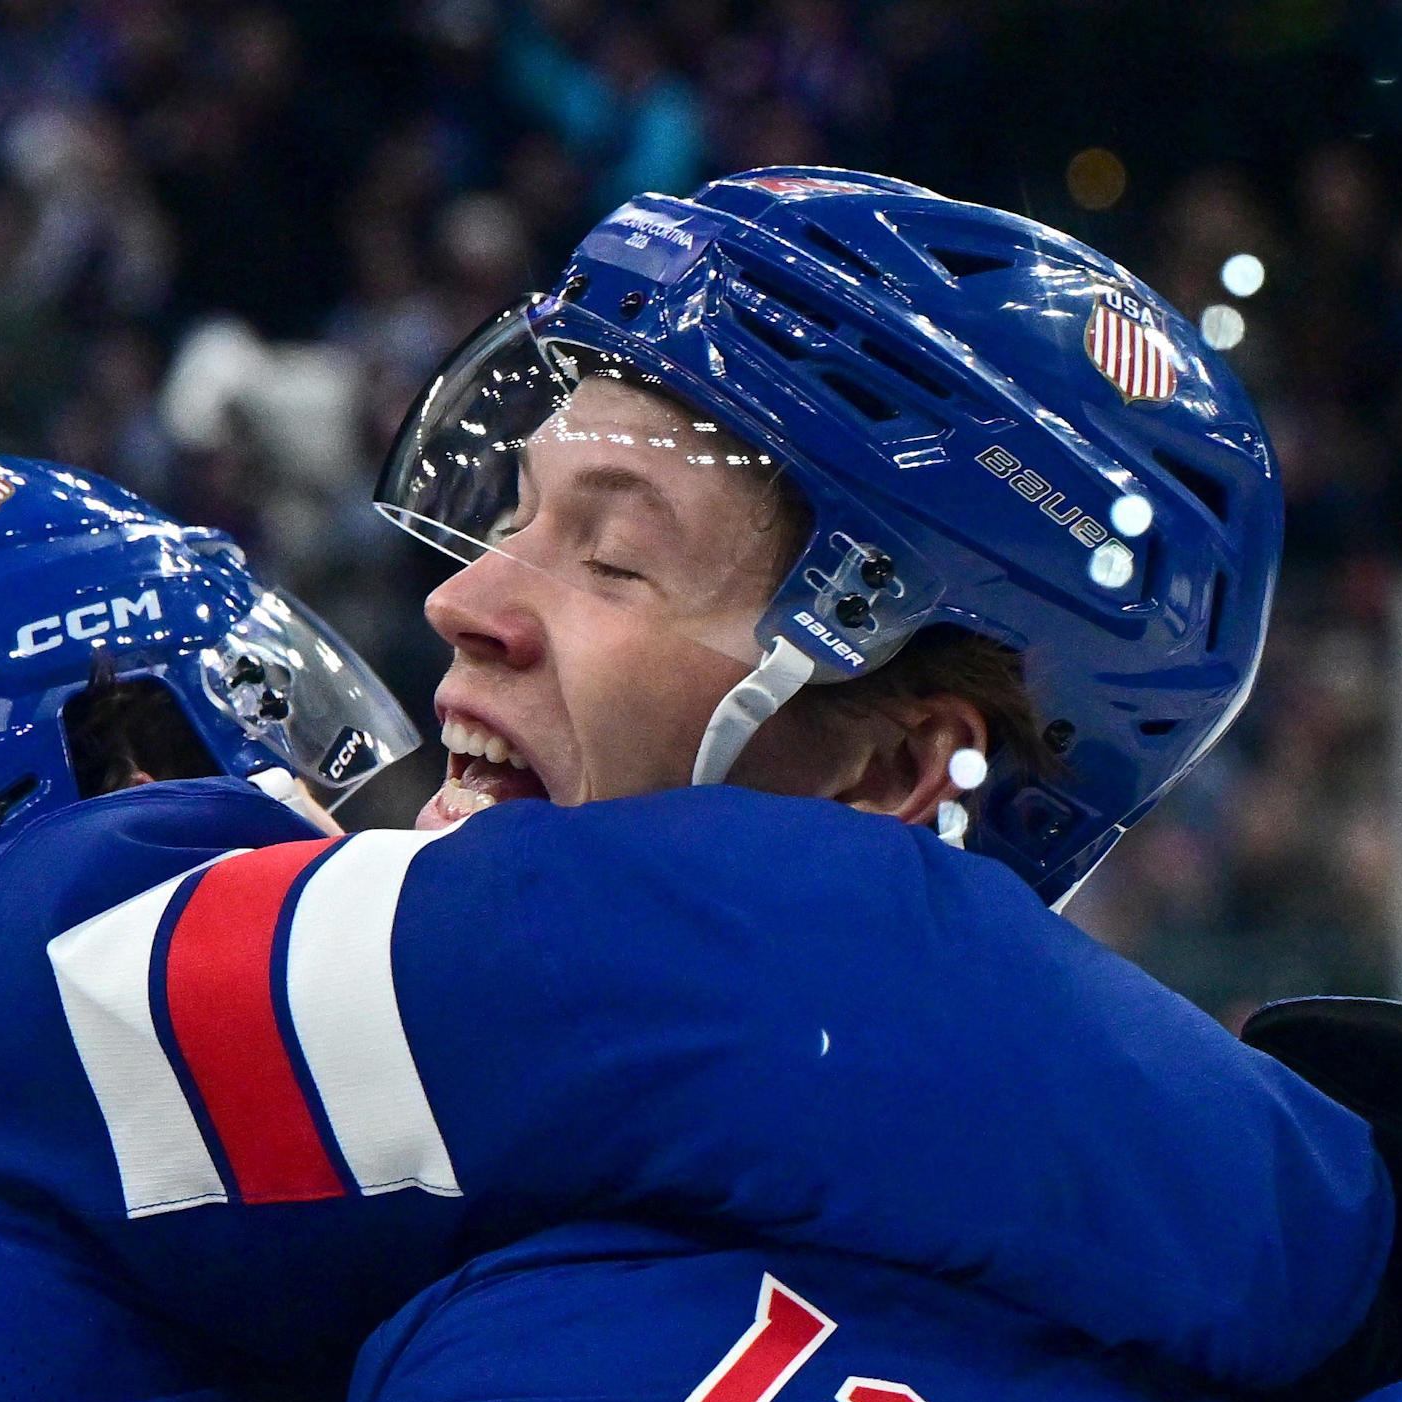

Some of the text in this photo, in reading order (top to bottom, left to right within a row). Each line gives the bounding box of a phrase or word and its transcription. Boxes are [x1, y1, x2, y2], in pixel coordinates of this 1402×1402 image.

[1105, 289, 1155, 329] USA
[16, 589, 162, 658] CCM
[329, 731, 362, 779] CCM
